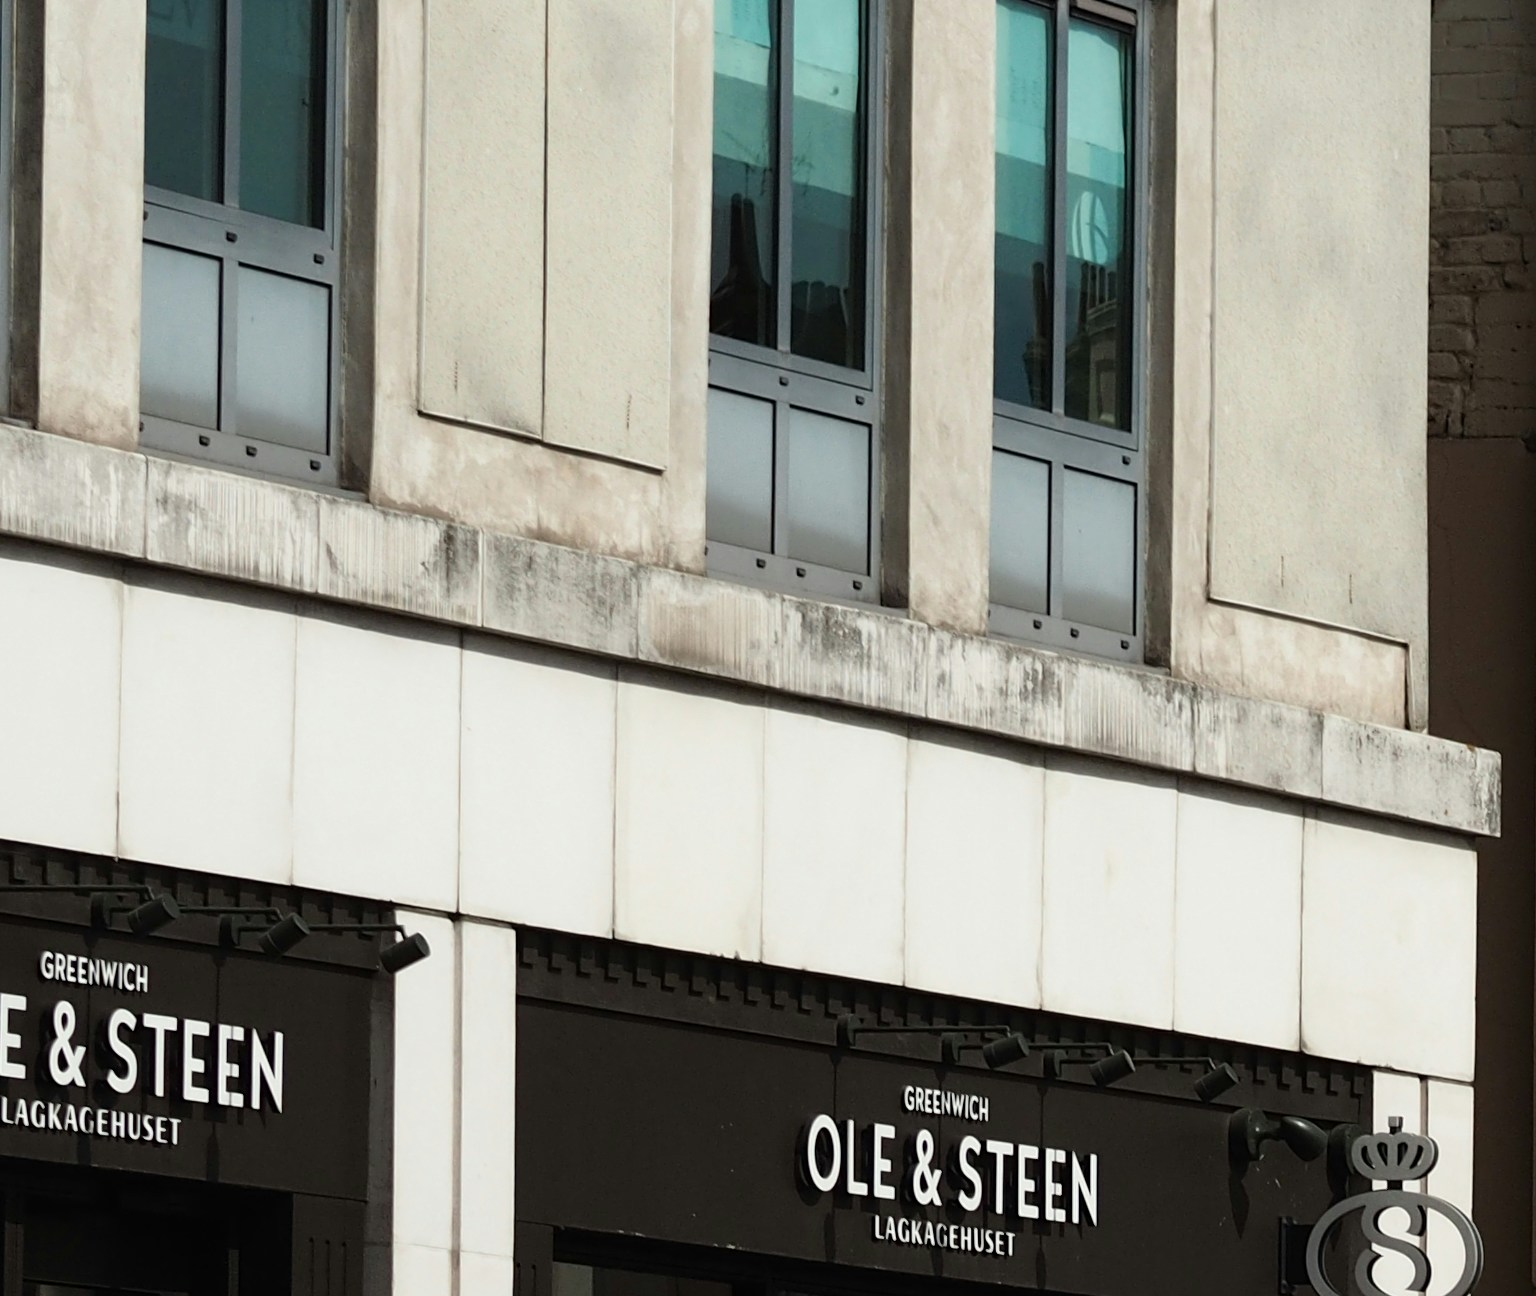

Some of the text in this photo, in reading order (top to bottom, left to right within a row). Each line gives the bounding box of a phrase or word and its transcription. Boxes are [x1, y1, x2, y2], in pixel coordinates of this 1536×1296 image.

[41, 951, 149, 993] GREENWICH
[49, 1000, 87, 1088] &
[106, 1007, 285, 1115] STEEN
[0, 1095, 182, 1146] LAGKAGEHUSET
[904, 1085, 989, 1122] GREENWICH
[807, 1113, 1099, 1228] OLE & STEEN
[874, 1214, 1017, 1257] LAGKAGEHUSET
